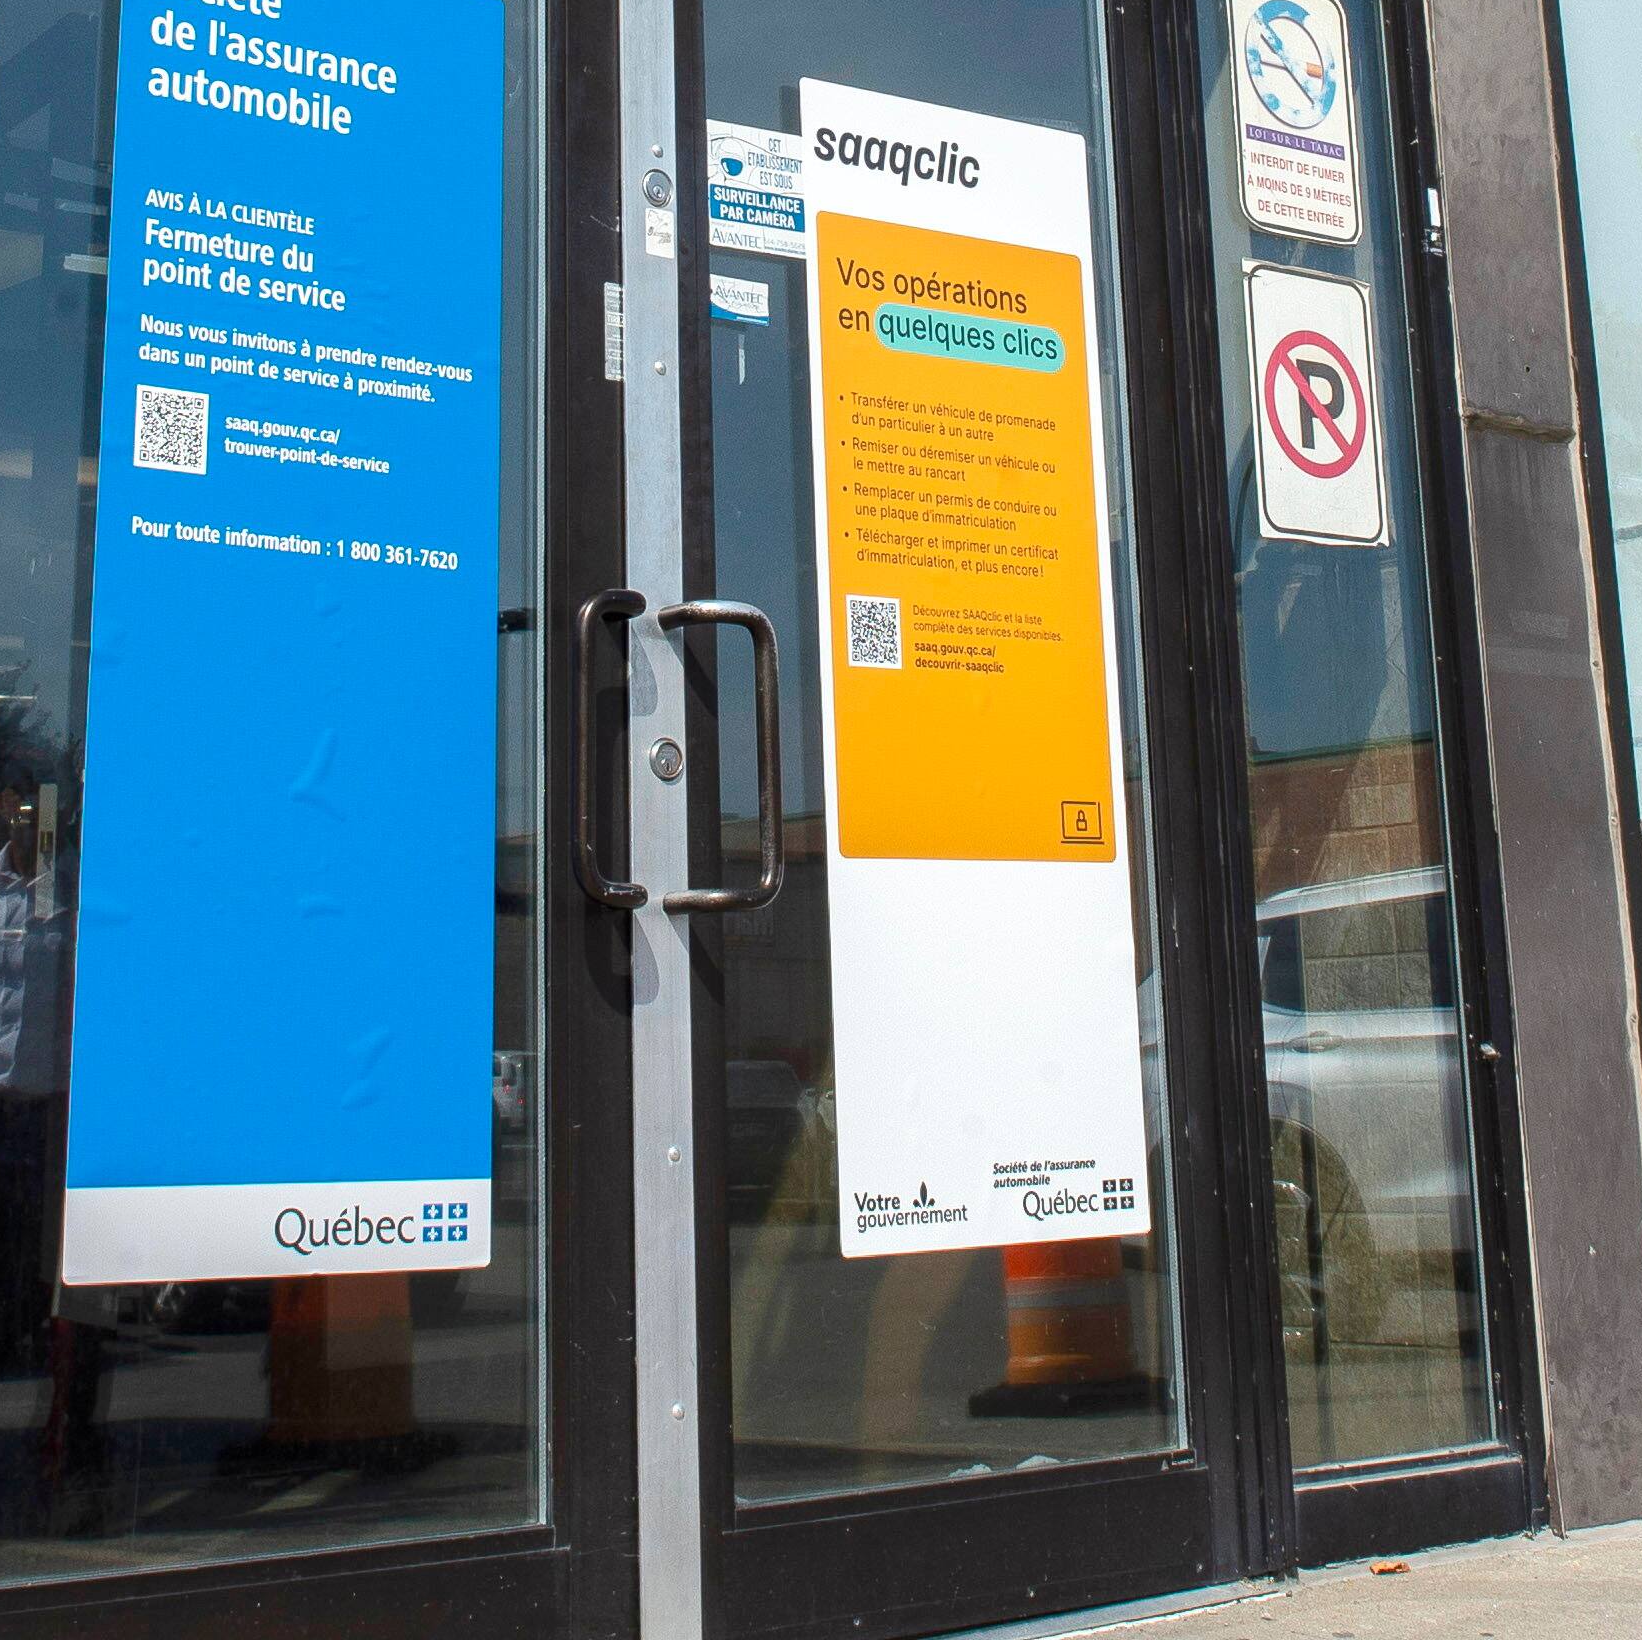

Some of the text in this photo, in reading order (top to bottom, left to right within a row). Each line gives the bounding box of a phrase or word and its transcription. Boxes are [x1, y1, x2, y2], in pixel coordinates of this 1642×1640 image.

[151, 11, 397, 94] de l'assurance
[148, 67, 352, 135] automobile
[768, 138, 781, 153] CET
[813, 126, 981, 189] saaqclic
[1249, 127, 1343, 157] LOI SUR LE TABAC
[748, 150, 803, 174] ÉTABLISSEMENT
[1250, 151, 1345, 183] INTERDIT DE FUMER
[760, 171, 793, 190] EST SOUS
[1256, 176, 1288, 193] MOINS
[1291, 183, 1303, 196] DE
[145, 189, 315, 236] AVIS À LA CLIENTÈLE
[713, 187, 801, 213] SURVEILLANCE
[1258, 199, 1344, 228] DE CETTE ENTRÉE
[720, 204, 795, 230] PAR CAMÉRA
[145, 219, 315, 273] Fermeture du
[711, 228, 762, 249] AVANTEC
[143, 259, 346, 312] point de service
[836, 256, 1028, 315] Vos opérations
[140, 314, 473, 383] Nous vous invitons à prendre rendez-vous
[838, 307, 1058, 360] en quelques clics
[139, 344, 436, 404] dans un point de service à proximité.
[851, 392, 1056, 432] Transférer un véhicule de promenade
[1296, 358, 1345, 450] P
[224, 414, 340, 445] saaq.gouv.qc.ca/
[852, 412, 995, 442] d'un particulier un autre
[224, 436, 390, 474] trouver-point-de-service
[852, 437, 1056, 474] Remiser ou déremiser un véhicule ou
[867, 460, 966, 482] mettre au rancart
[854, 483, 1057, 517] Remplacer un permis de conduire ou
[855, 504, 1017, 532] une plaque d'immatriculation
[131, 515, 458, 570] Pour toute information 1 800 361-7620
[856, 527, 1059, 561] Télécharger et imprimer un certificat
[960, 559, 973, 571] et
[975, 559, 998, 577] plus
[913, 604, 1042, 625] Découvrez SAAQclic liste
[957, 624, 973, 635] des
[976, 626, 1011, 638] services
[914, 642, 996, 658] saaq.gouv.qc.ca/
[993, 1159, 1096, 1175] Société de l'assurance
[993, 1175, 1051, 1189] automobile
[854, 1192, 901, 1212] Votre
[1023, 1188, 1099, 1221] Québec
[274, 1204, 416, 1256] Québec
[857, 1205, 968, 1233] gouvernement
